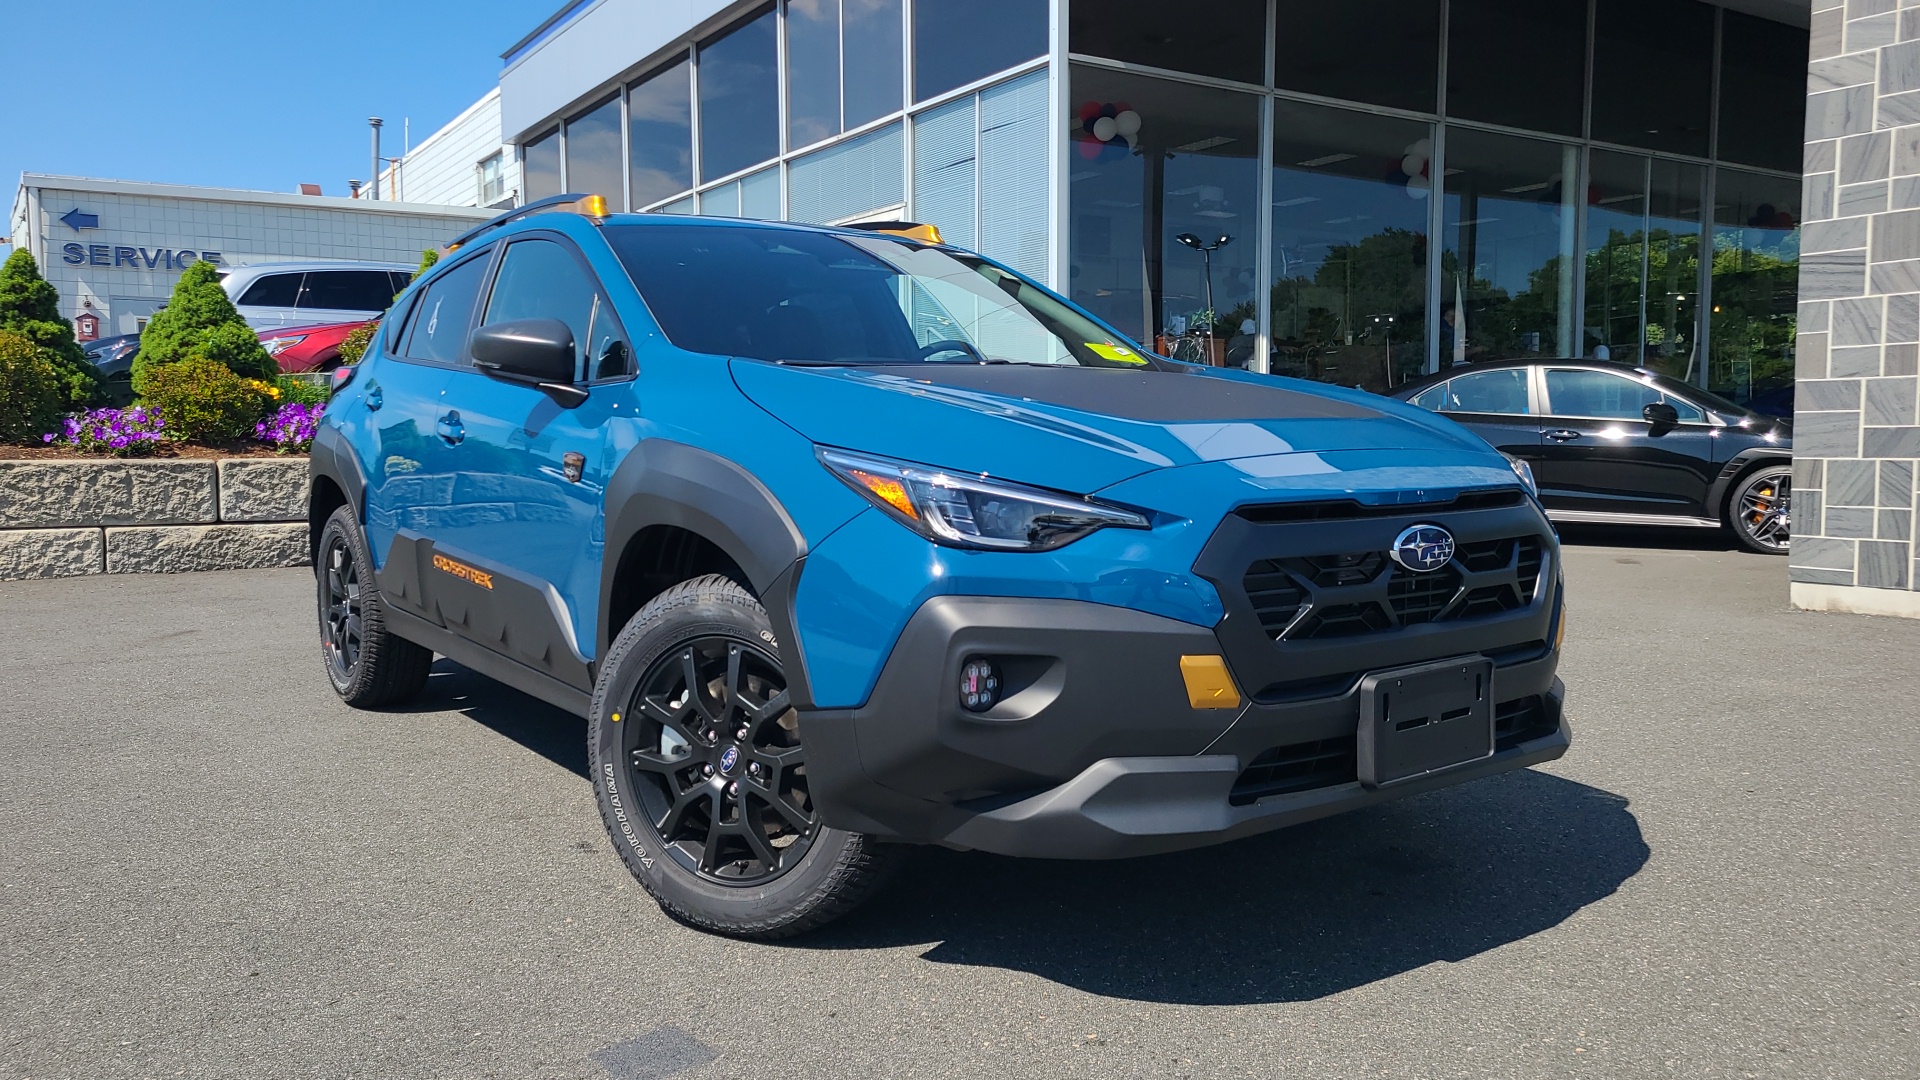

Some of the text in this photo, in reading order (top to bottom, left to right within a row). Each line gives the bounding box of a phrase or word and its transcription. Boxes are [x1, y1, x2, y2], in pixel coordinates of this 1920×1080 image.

[63, 242, 222, 271] SERVICE
[433, 554, 494, 590] CROSSTREK
[604, 763, 655, 869] YOKOHAMA
